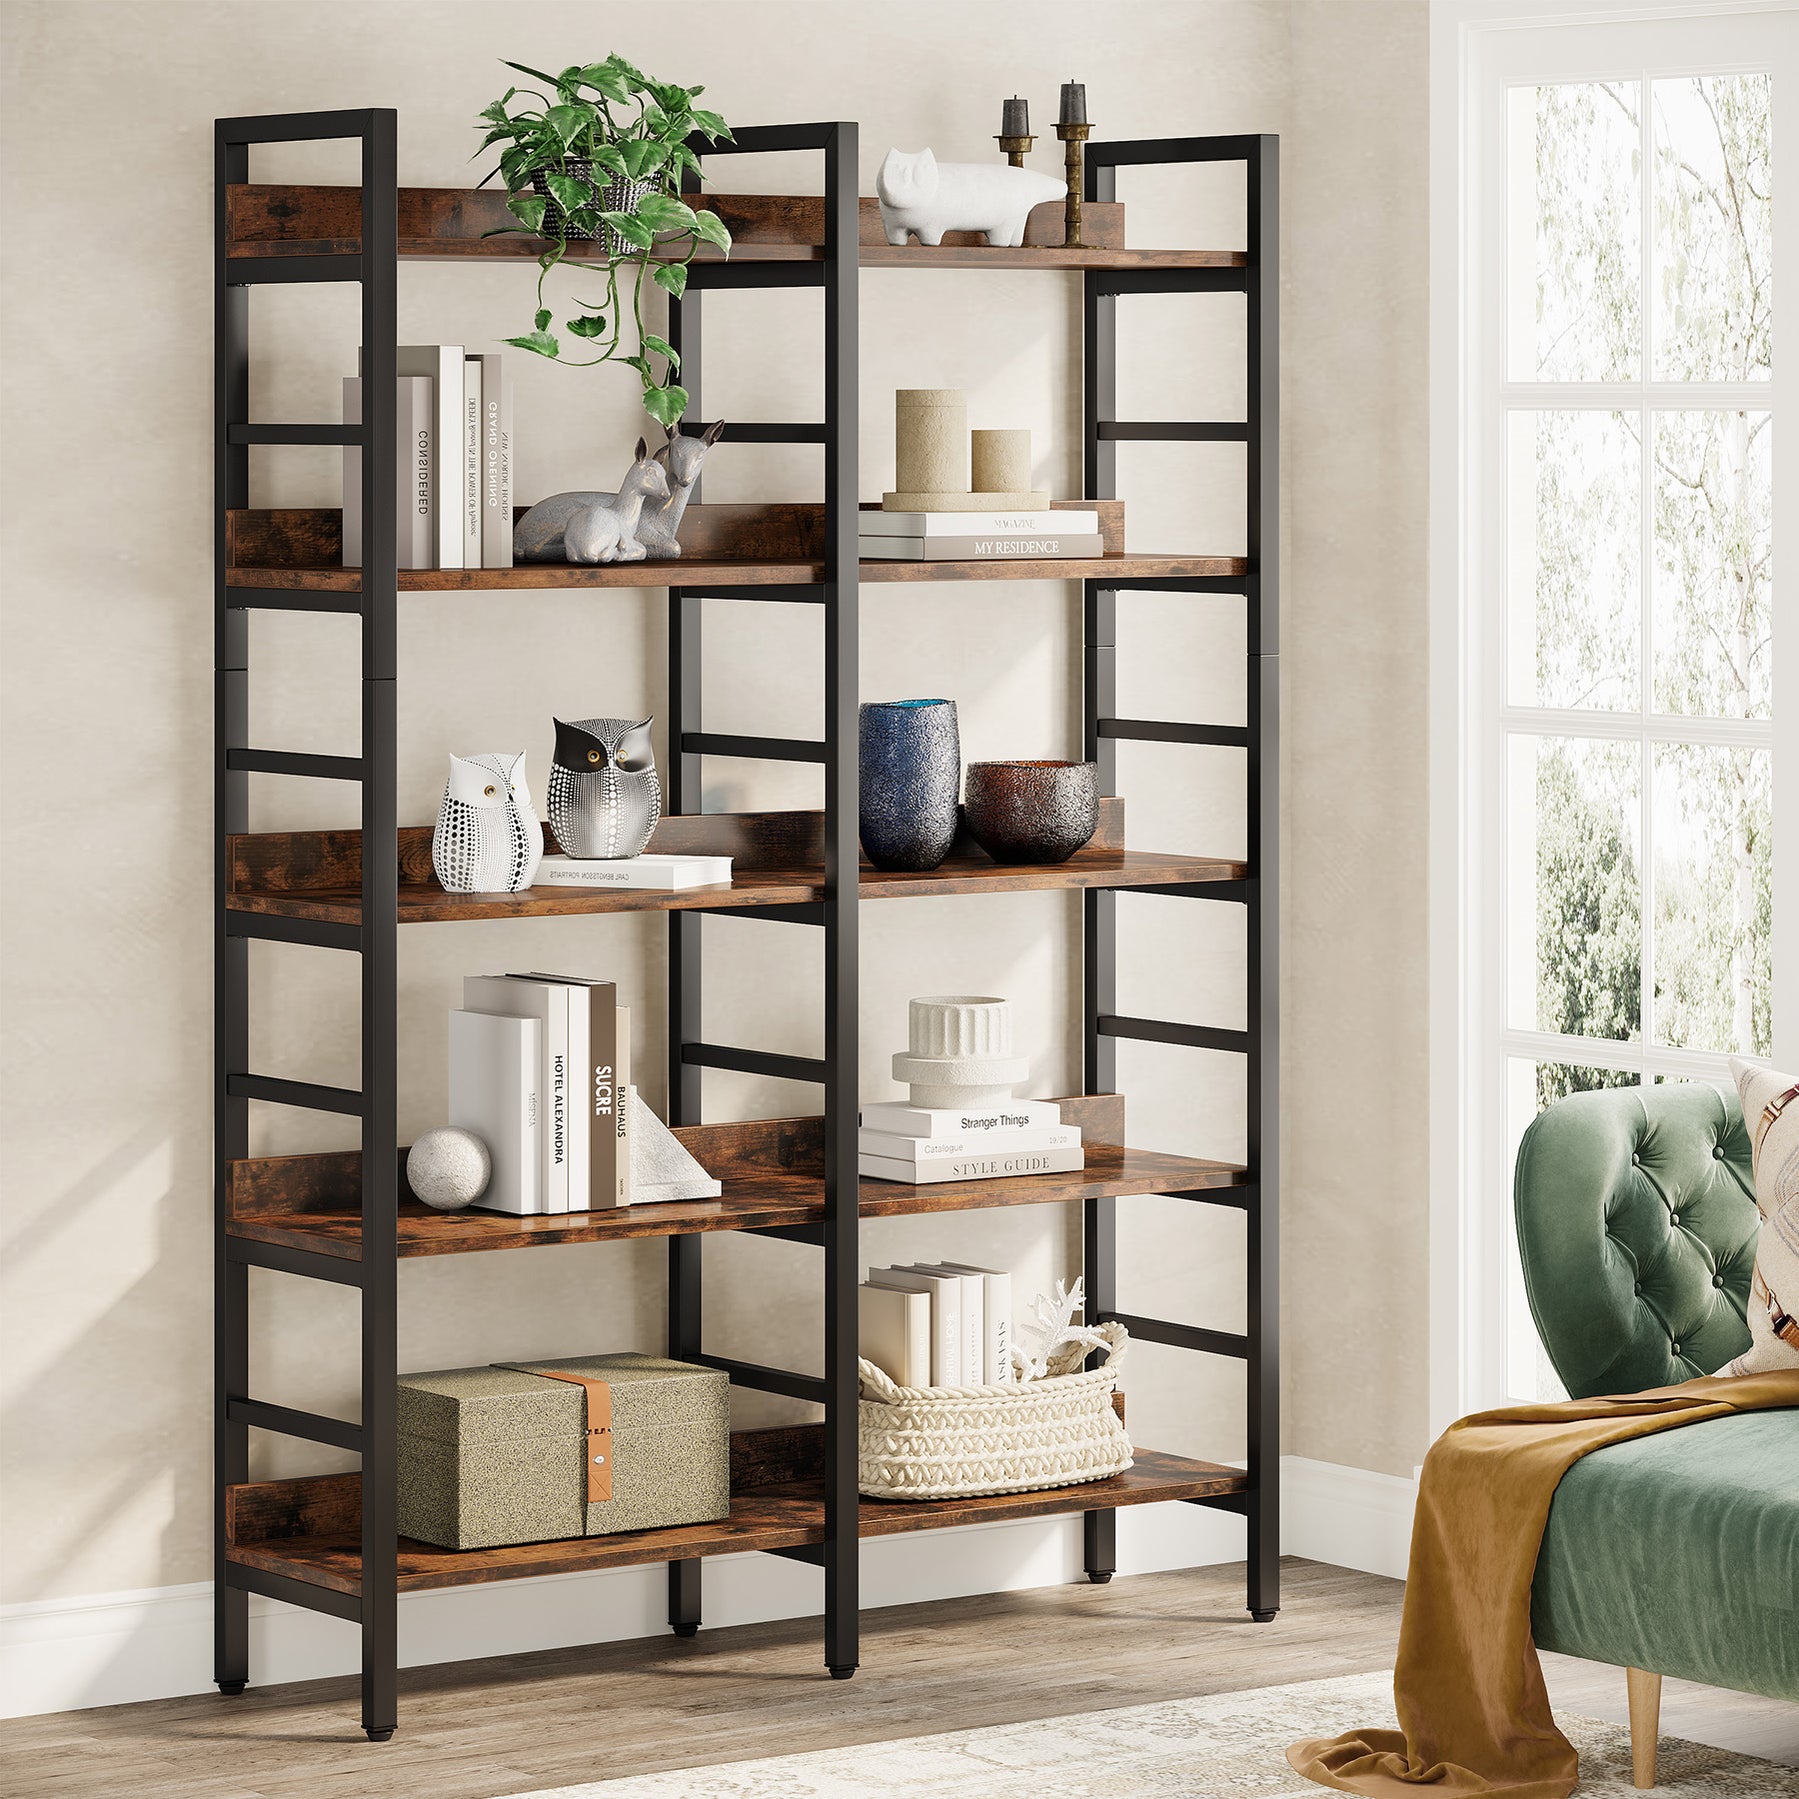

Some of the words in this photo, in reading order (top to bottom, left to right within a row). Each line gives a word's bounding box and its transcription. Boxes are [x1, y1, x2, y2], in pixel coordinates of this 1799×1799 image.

[975, 541, 993, 555] MY
[995, 540, 1060, 554] RESIDENCE
[554, 1055, 564, 1093] HOTEL
[595, 1065, 613, 1116] SUCRE
[617, 1086, 626, 1138] BAUHAUS
[961, 1116, 998, 1131] Stranger
[999, 1114, 1030, 1128] Things
[554, 1094, 564, 1165] ALEXANDRA
[924, 1143, 964, 1154] Catalogue
[953, 1161, 998, 1176] STYLE
[1004, 1157, 1050, 1171] GUIDE
